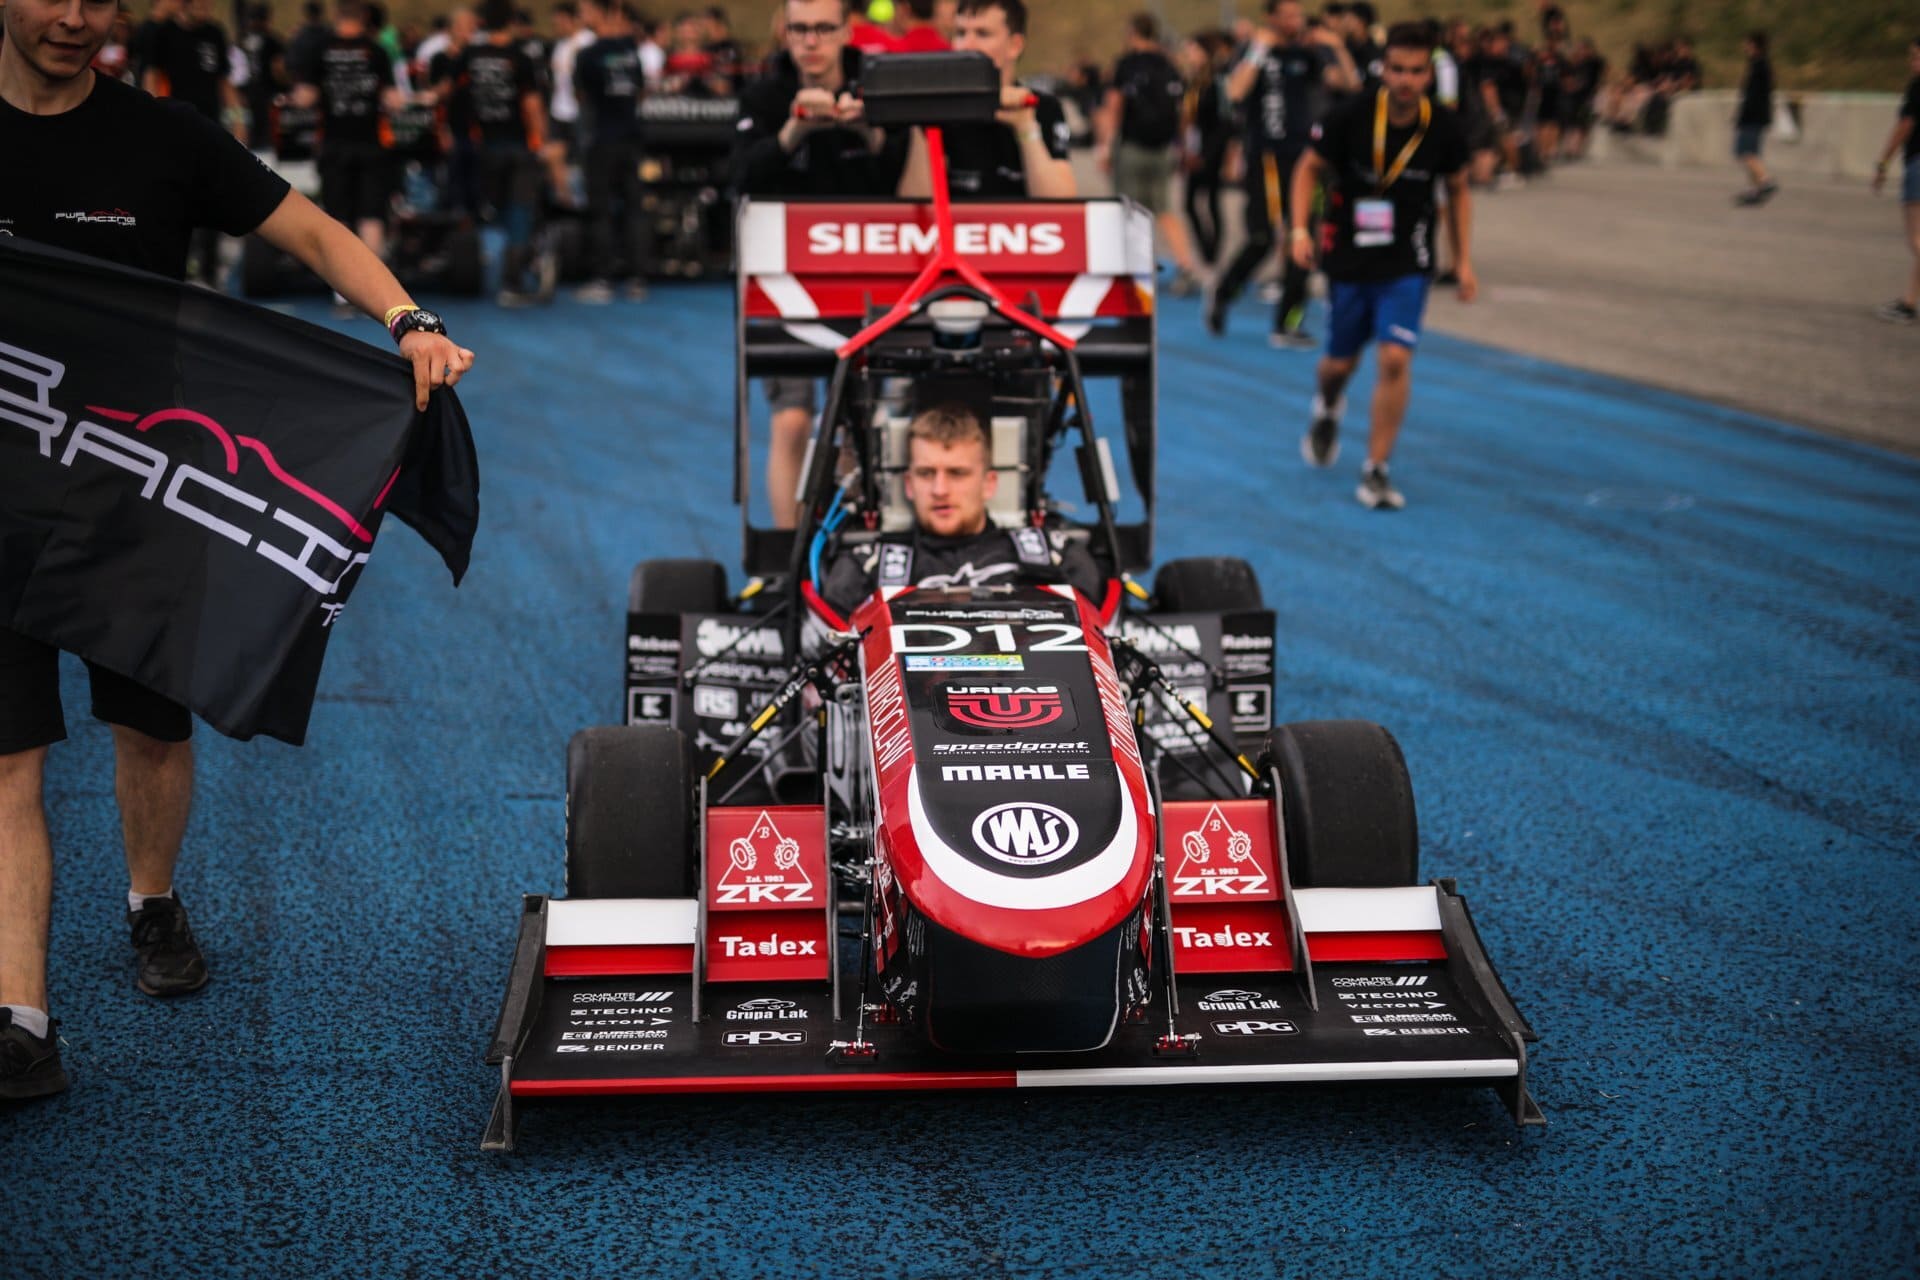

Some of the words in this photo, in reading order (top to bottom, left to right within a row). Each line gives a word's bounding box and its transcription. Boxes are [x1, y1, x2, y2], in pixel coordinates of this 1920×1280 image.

[808, 222, 1065, 255] SIEMENS
[889, 624, 1089, 653] D12
[946, 686, 1058, 694] URBAS
[933, 741, 1089, 751] speedgoat
[941, 764, 1089, 781] MAHLE
[1173, 876, 1269, 895] ZKZ
[716, 884, 813, 903] ZKZ
[1173, 925, 1272, 948] Tadex
[718, 933, 816, 957] Tadex
[1356, 991, 1438, 999] TECHNO
[591, 1007, 673, 1015] TECHNO
[1198, 1001, 1247, 1011] Grupa
[1249, 999, 1281, 1010] Lak
[726, 1010, 773, 1020] Grupa
[779, 1009, 808, 1019] Lak
[1216, 1021, 1293, 1034] PPG
[727, 1031, 802, 1044] PPG
